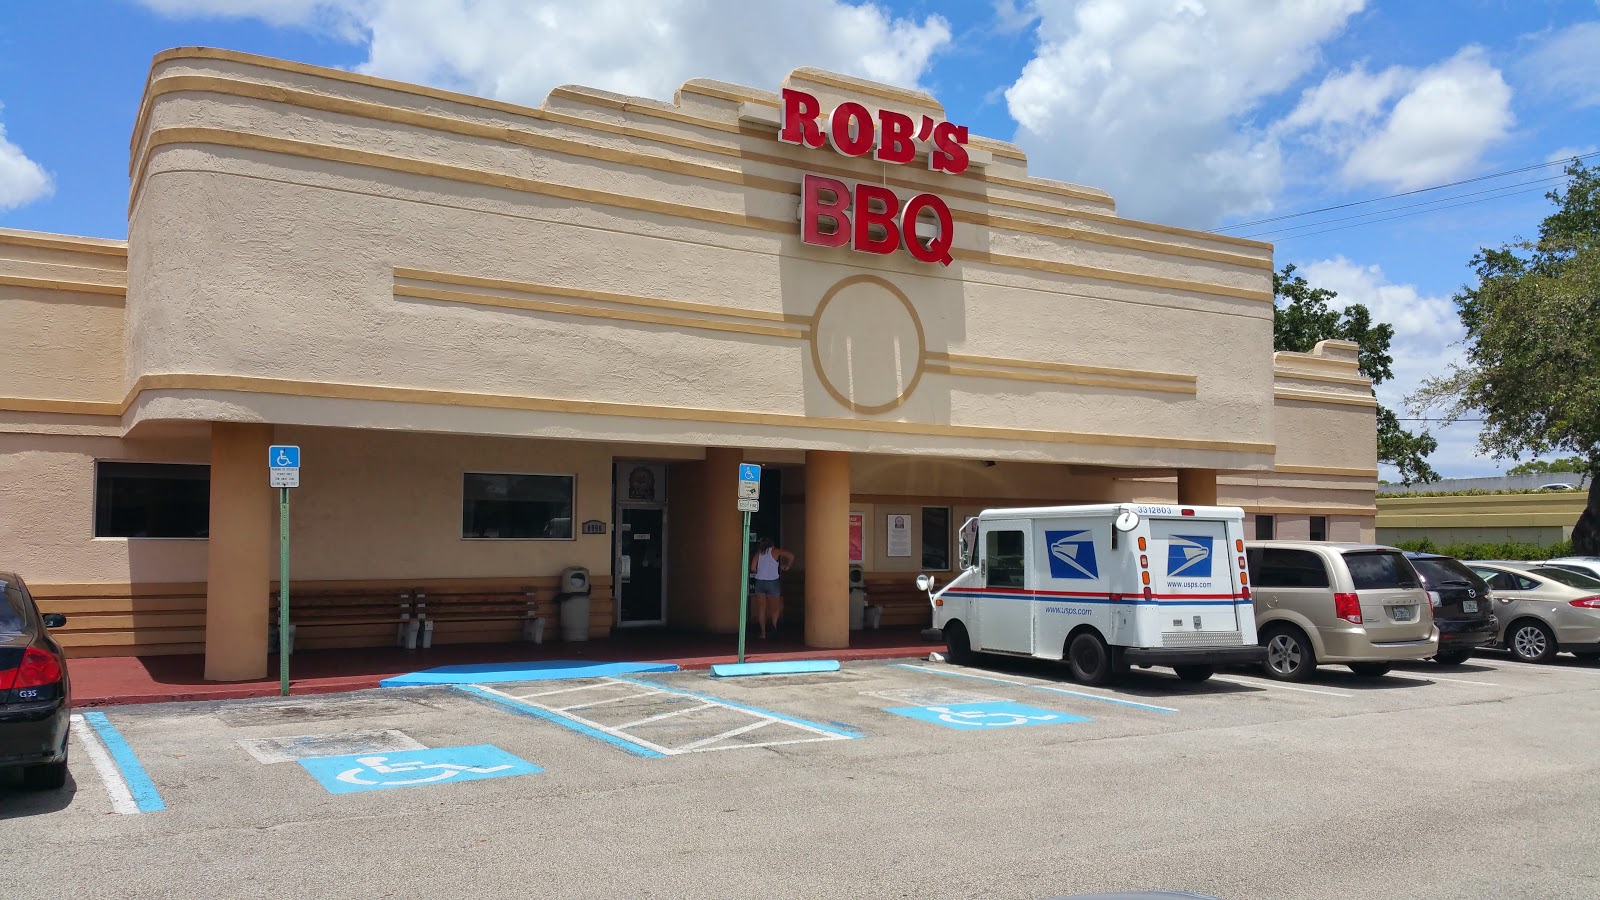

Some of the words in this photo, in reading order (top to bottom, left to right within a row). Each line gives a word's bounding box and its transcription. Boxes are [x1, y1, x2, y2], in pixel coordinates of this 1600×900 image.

[778, 88, 970, 175] ROB'S
[801, 173, 954, 267] BBQ
[1137, 505, 1172, 514] 3312803
[1167, 581, 1212, 589] www.usps.com
[1045, 605, 1092, 616] www.usps.com
